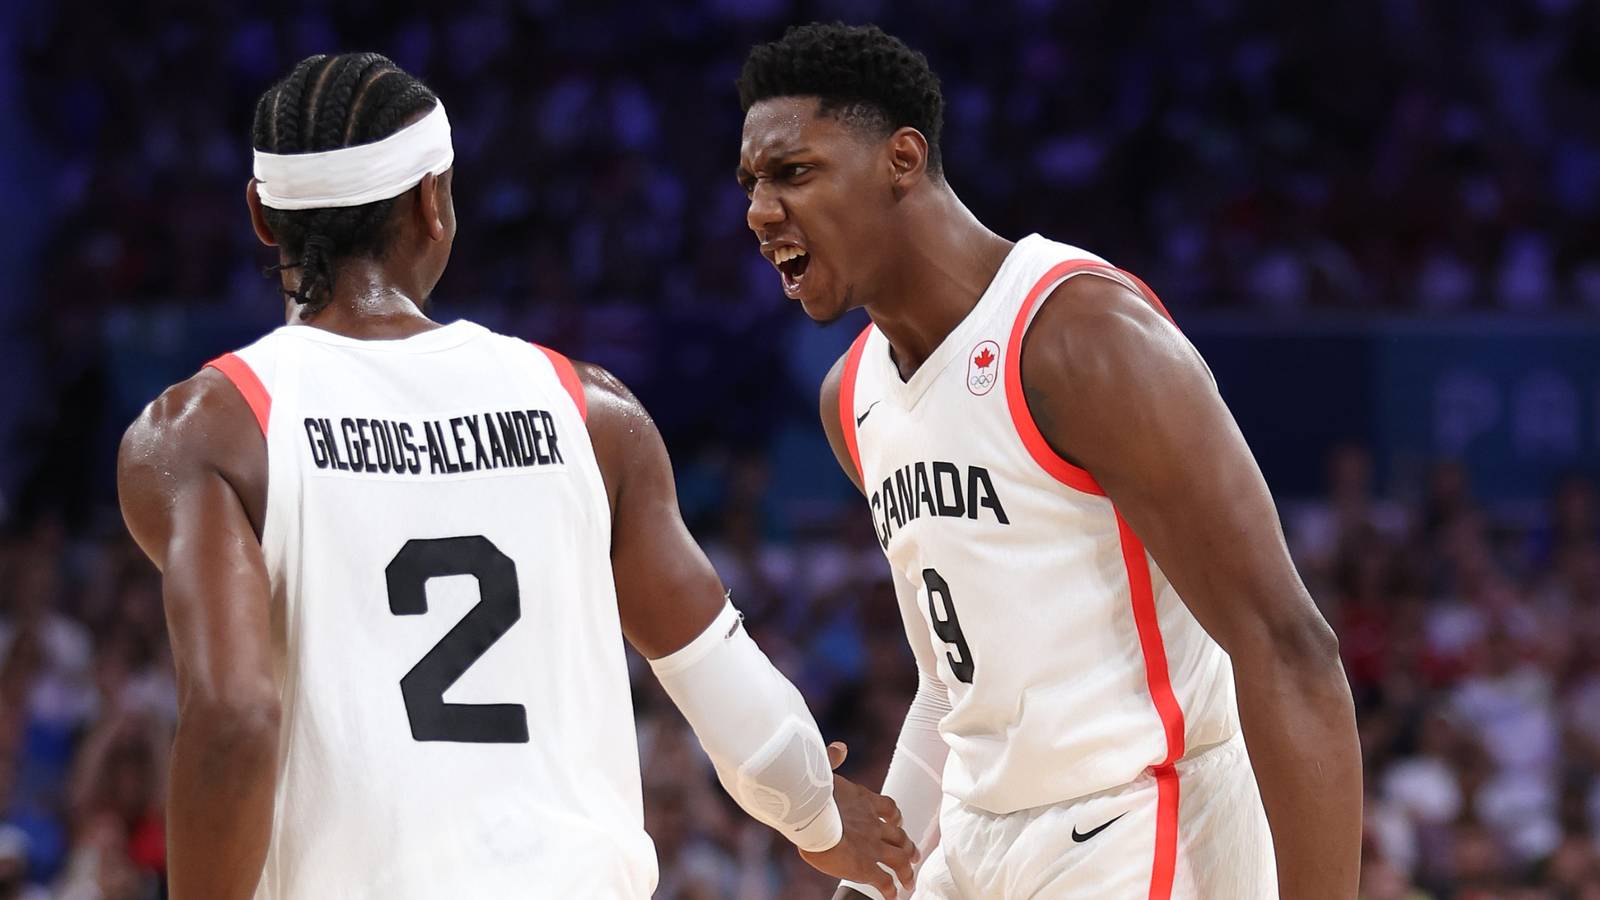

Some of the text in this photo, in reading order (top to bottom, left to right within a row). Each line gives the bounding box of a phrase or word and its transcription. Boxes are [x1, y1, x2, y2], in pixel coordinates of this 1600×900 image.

[303, 409, 565, 475] GILGEOUS-ALEXANDER
[871, 461, 1010, 551] CANADA
[385, 535, 530, 744] 2
[922, 568, 975, 684] 9
